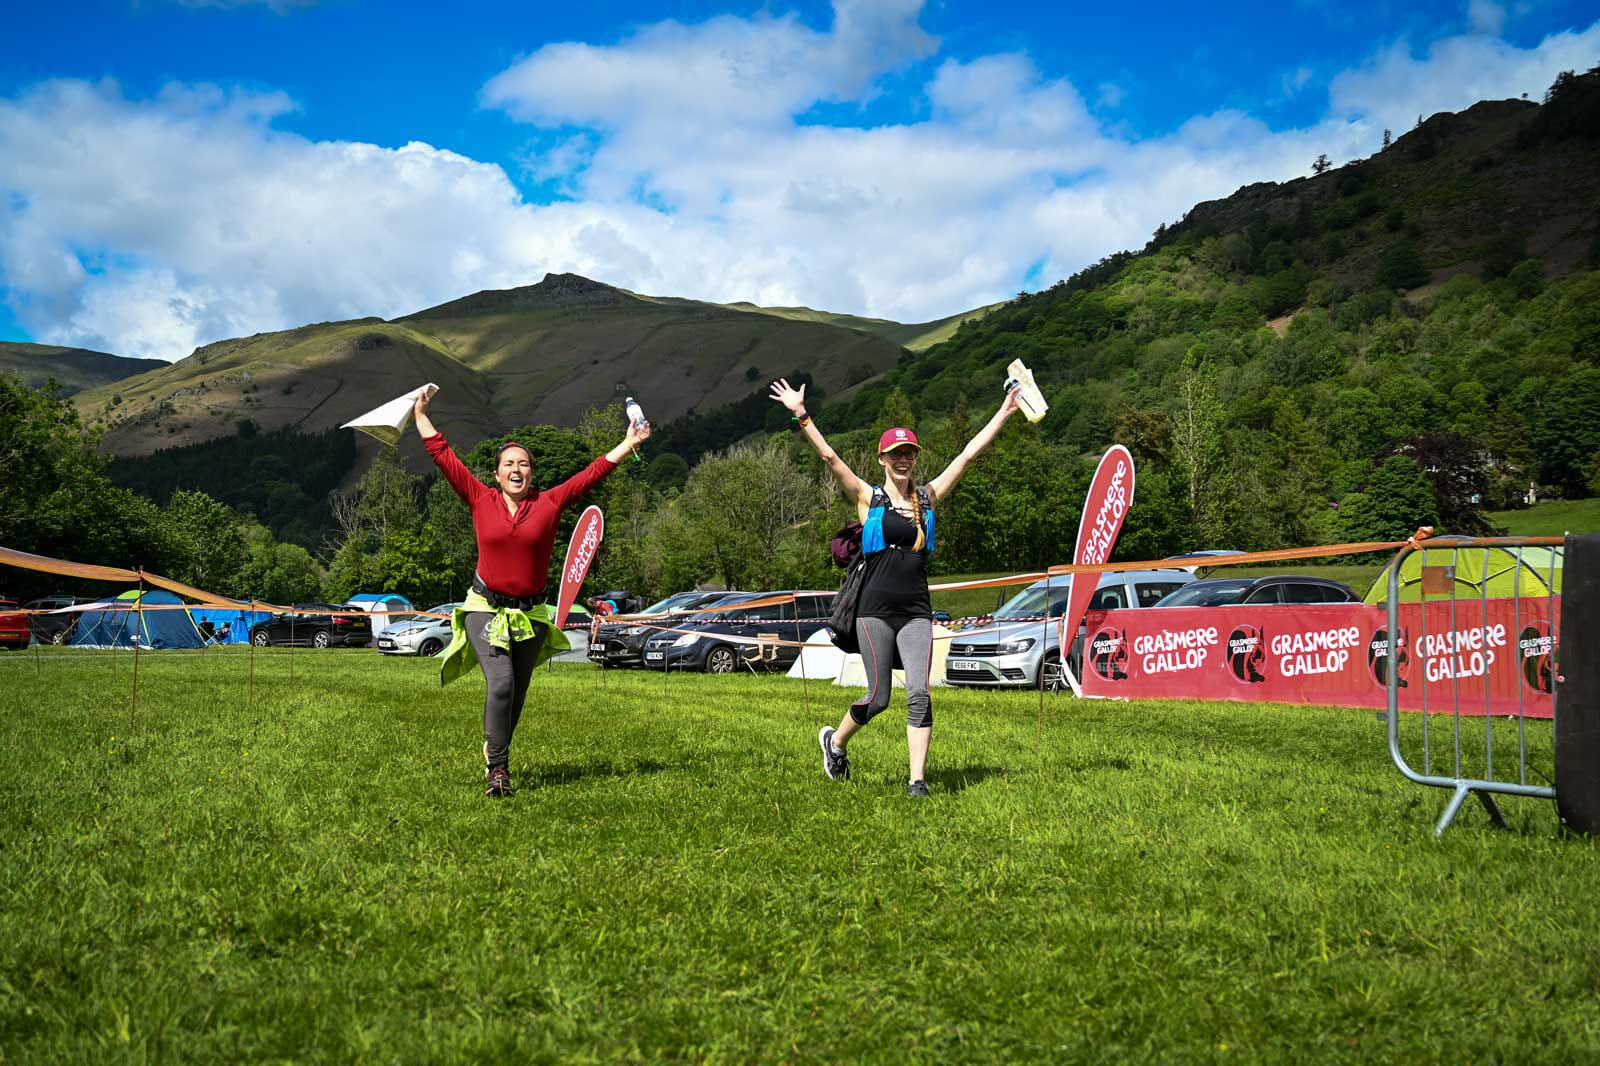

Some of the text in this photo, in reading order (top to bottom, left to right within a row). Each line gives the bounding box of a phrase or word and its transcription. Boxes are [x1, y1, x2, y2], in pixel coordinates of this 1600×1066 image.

[1092, 486, 1126, 565] GALLOP
[574, 530, 598, 583] GALLOP
[1142, 647, 1208, 675] GALLOP
[1280, 649, 1349, 677] GALLOP
[1426, 649, 1495, 682] GALLOP
